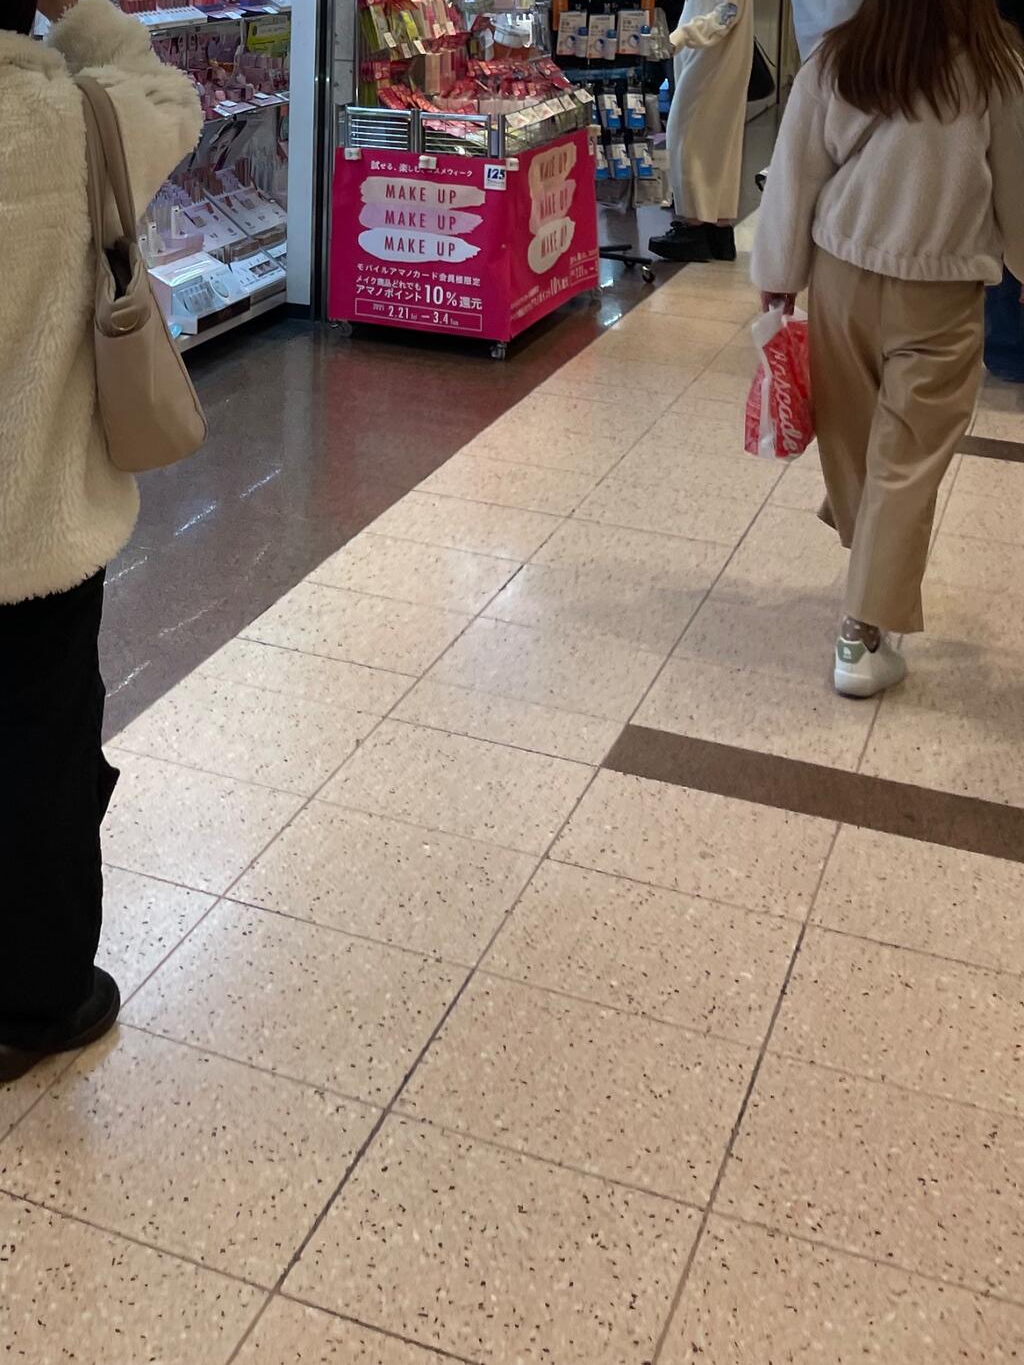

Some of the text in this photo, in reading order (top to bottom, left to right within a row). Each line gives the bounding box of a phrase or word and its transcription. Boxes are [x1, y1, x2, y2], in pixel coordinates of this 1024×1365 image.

[370, 160, 473, 178] 試せる、楽しむ、スメウィーク
[487, 167, 505, 180] 125
[385, 184, 457, 204] MAKE UP
[385, 210, 457, 230] MAKE UP
[384, 235, 456, 257] MAKE UP
[356, 284, 422, 302] アマノポイント
[388, 305, 409, 320] 2.21
[433, 311, 449, 326] 3.4
